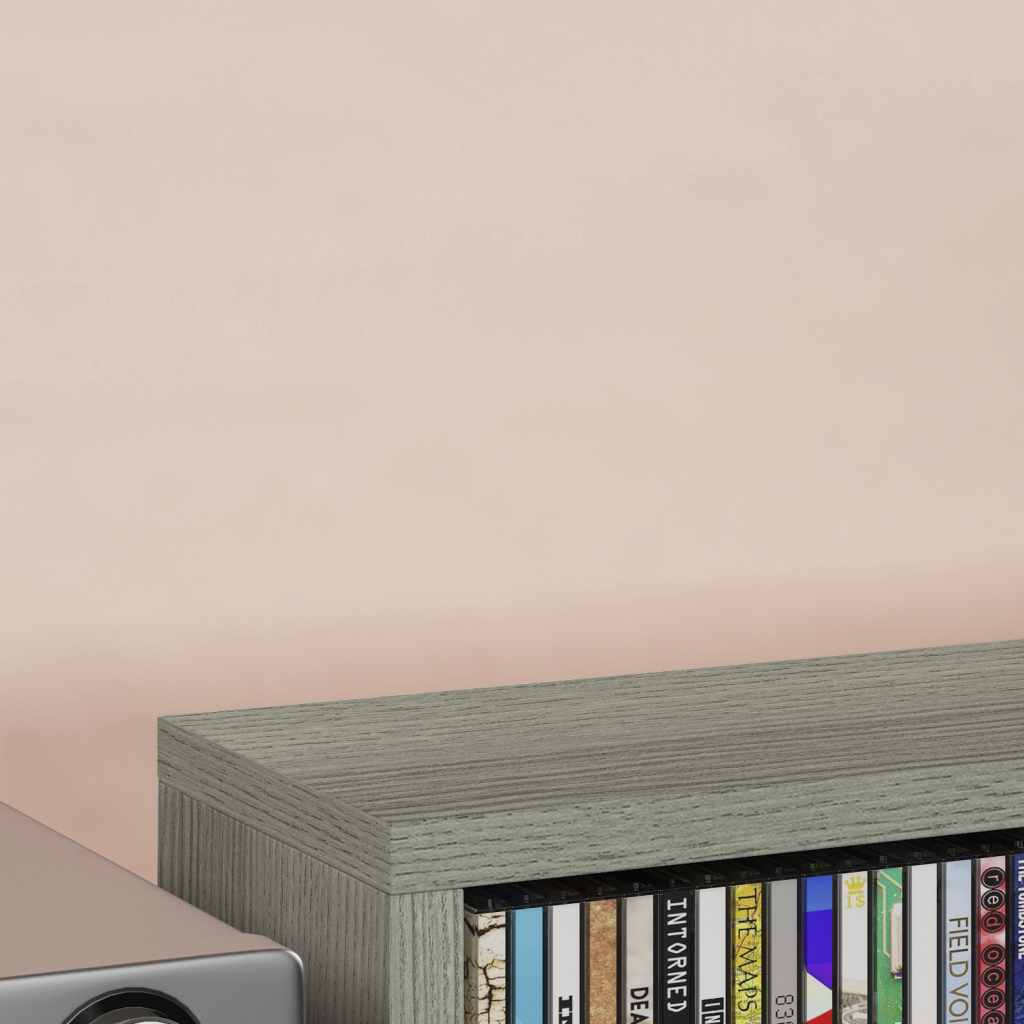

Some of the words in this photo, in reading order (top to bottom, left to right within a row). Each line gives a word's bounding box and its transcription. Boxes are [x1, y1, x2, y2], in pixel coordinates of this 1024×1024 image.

[738, 888, 757, 940] THE
[981, 867, 1006, 933] red
[667, 897, 687, 1013] INTORNED
[737, 944, 758, 1012] MAPS
[949, 917, 969, 978] FIELD
